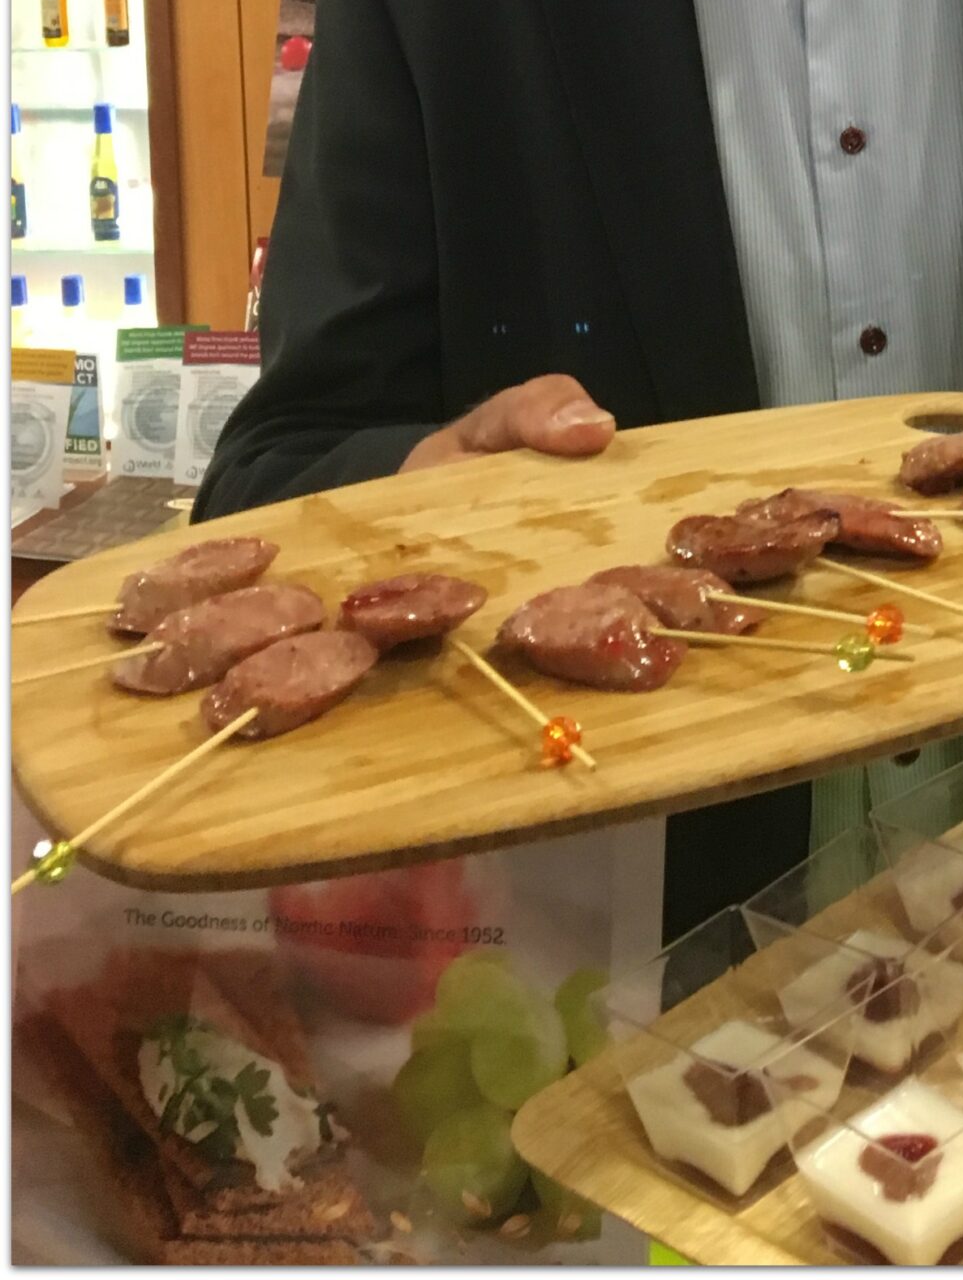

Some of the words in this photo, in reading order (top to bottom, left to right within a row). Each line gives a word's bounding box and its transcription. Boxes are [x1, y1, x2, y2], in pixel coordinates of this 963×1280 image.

[74, 359, 95, 371] MO
[65, 438, 98, 451] FIED
[124, 908, 156, 926] The
[161, 910, 247, 932] Goodness
[252, 916, 270, 932] of
[275, 918, 336, 937] Nordic
[463, 926, 507, 946] 1952.
